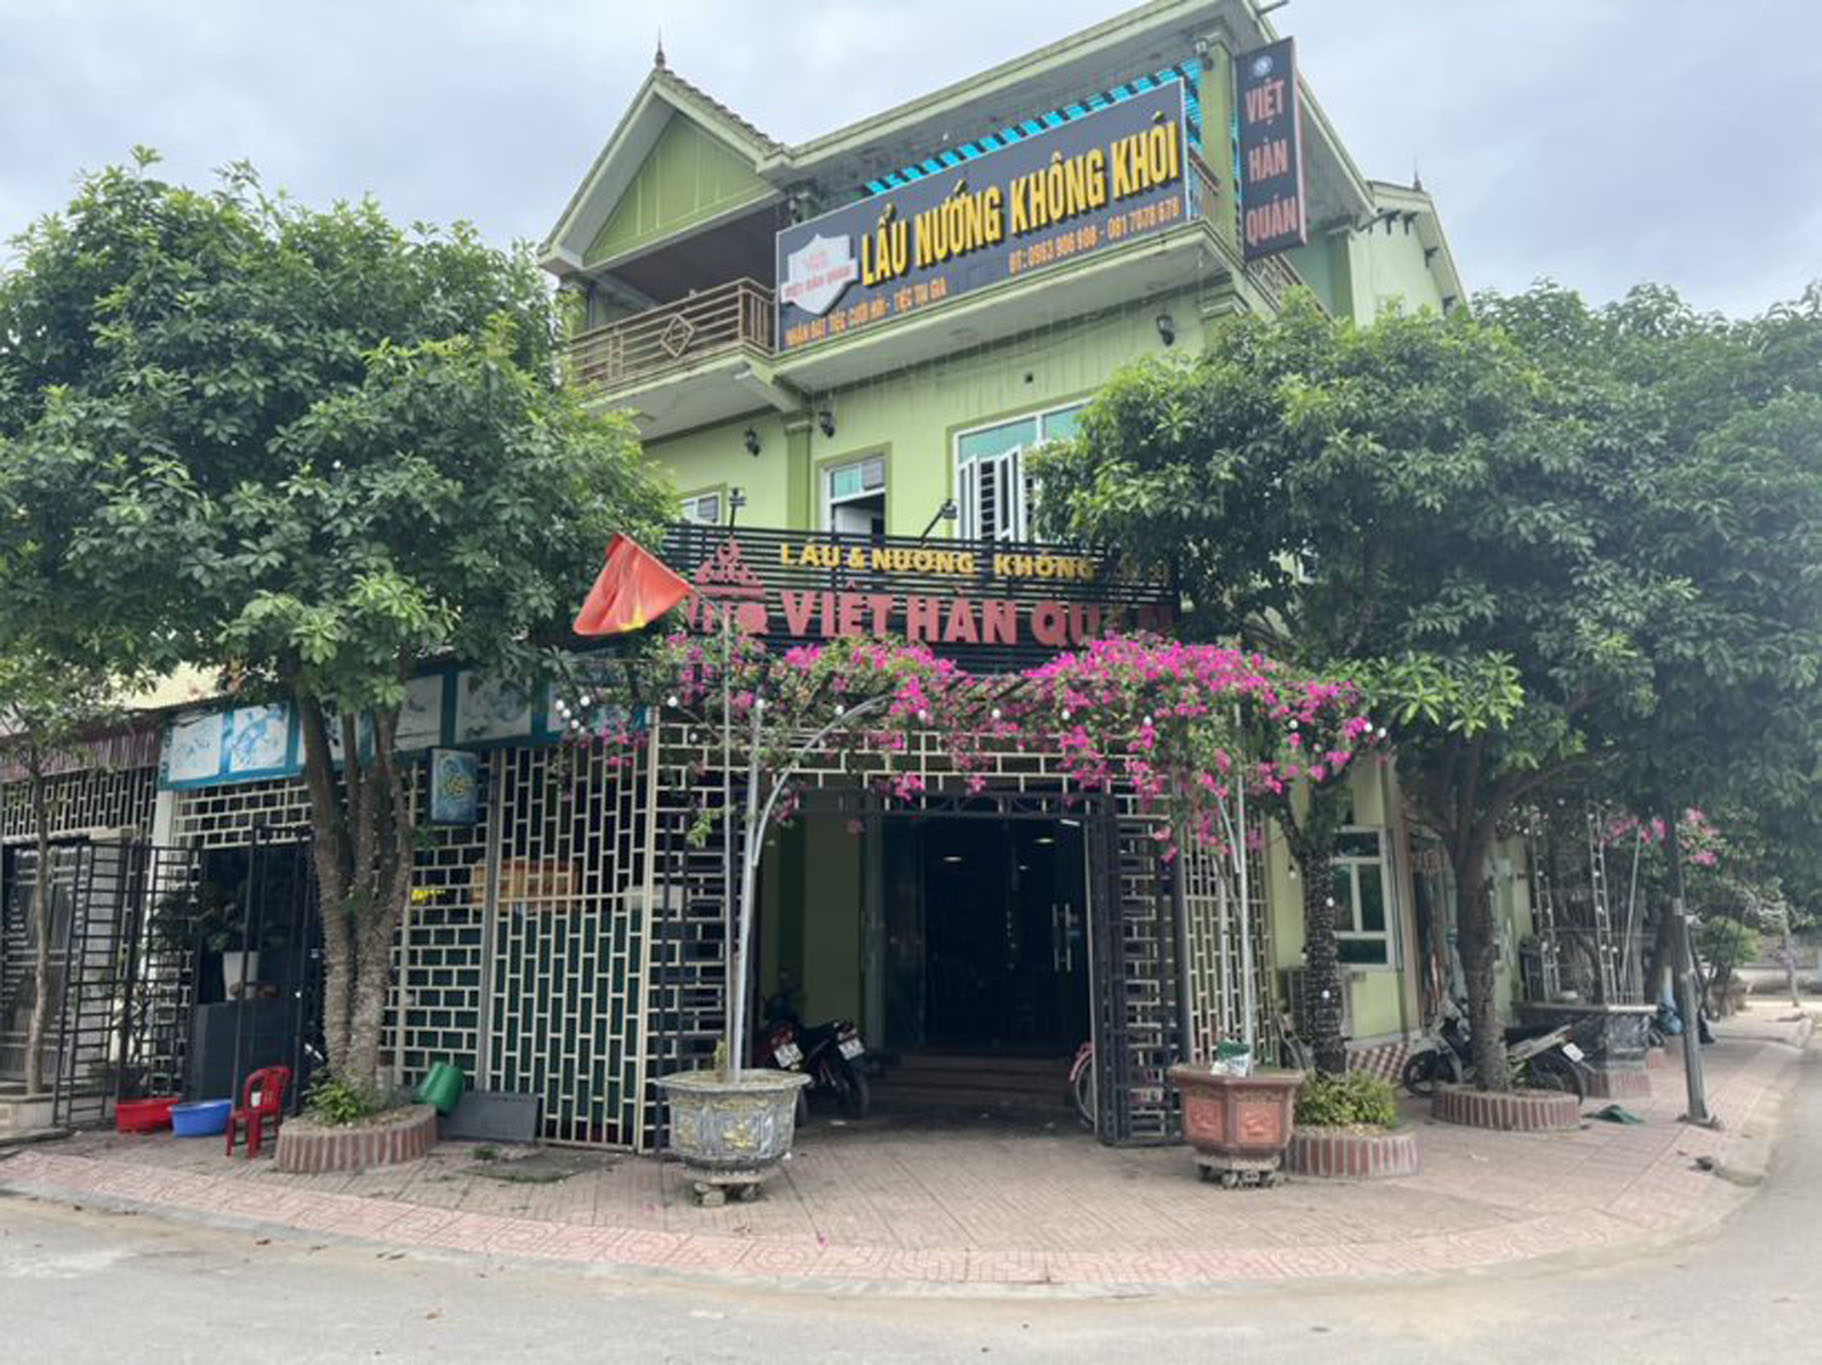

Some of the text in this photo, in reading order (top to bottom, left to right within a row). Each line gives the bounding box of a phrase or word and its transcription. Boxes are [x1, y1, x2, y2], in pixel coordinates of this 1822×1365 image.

[1246, 78, 1284, 125] VIỆT
[1249, 136, 1287, 182] HÀN
[915, 180, 1002, 267] NƯỚNG
[1011, 151, 1105, 234] KHÔNG
[1111, 111, 1179, 198] KHÓI
[1246, 195, 1298, 247] QUÁN
[849, 547, 865, 571] &
[907, 584, 1017, 645] HÀN
